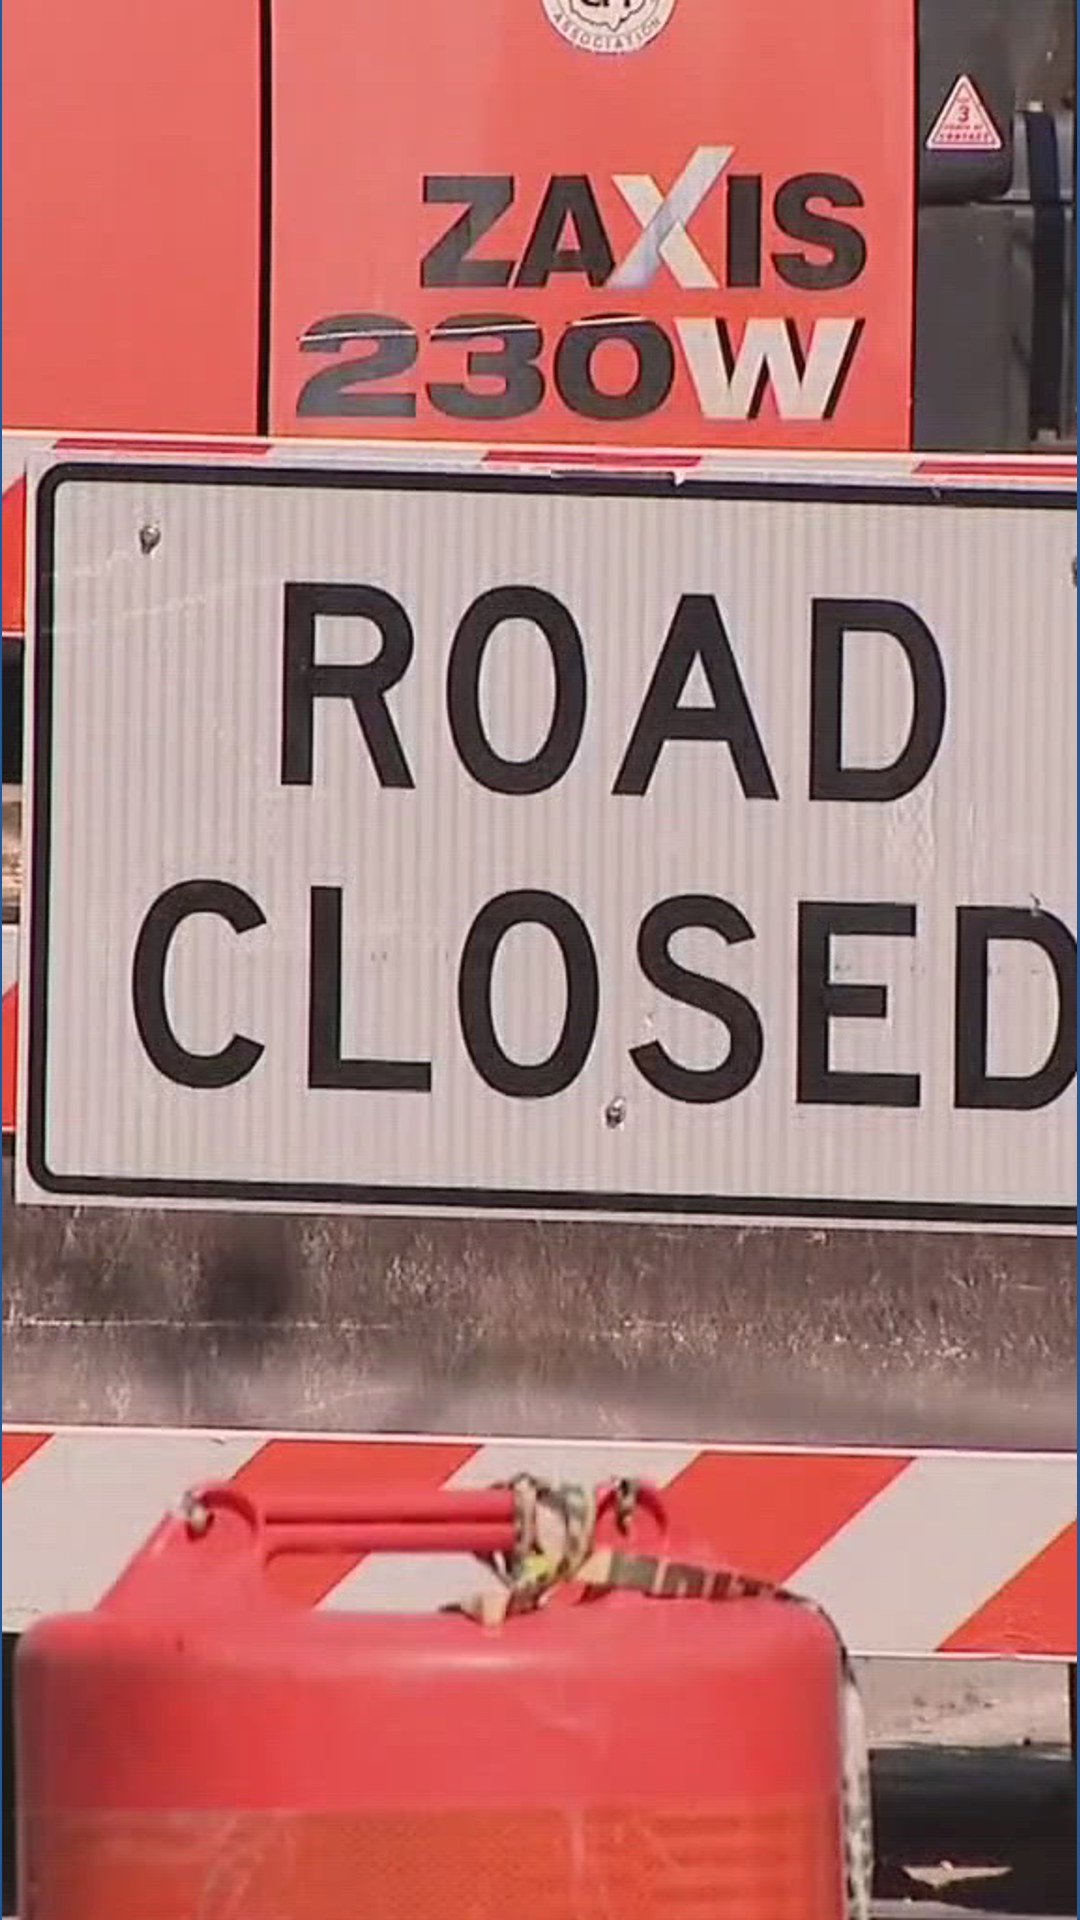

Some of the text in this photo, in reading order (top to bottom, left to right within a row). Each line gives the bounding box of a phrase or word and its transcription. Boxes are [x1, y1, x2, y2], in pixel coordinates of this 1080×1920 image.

[553, 14, 661, 49] ASSOCIATION
[958, 105, 969, 122] 3
[420, 146, 868, 291] ZAXIS
[296, 312, 867, 422] 230W
[281, 582, 947, 803] ROAD
[132, 879, 1078, 1110] CLOSED
